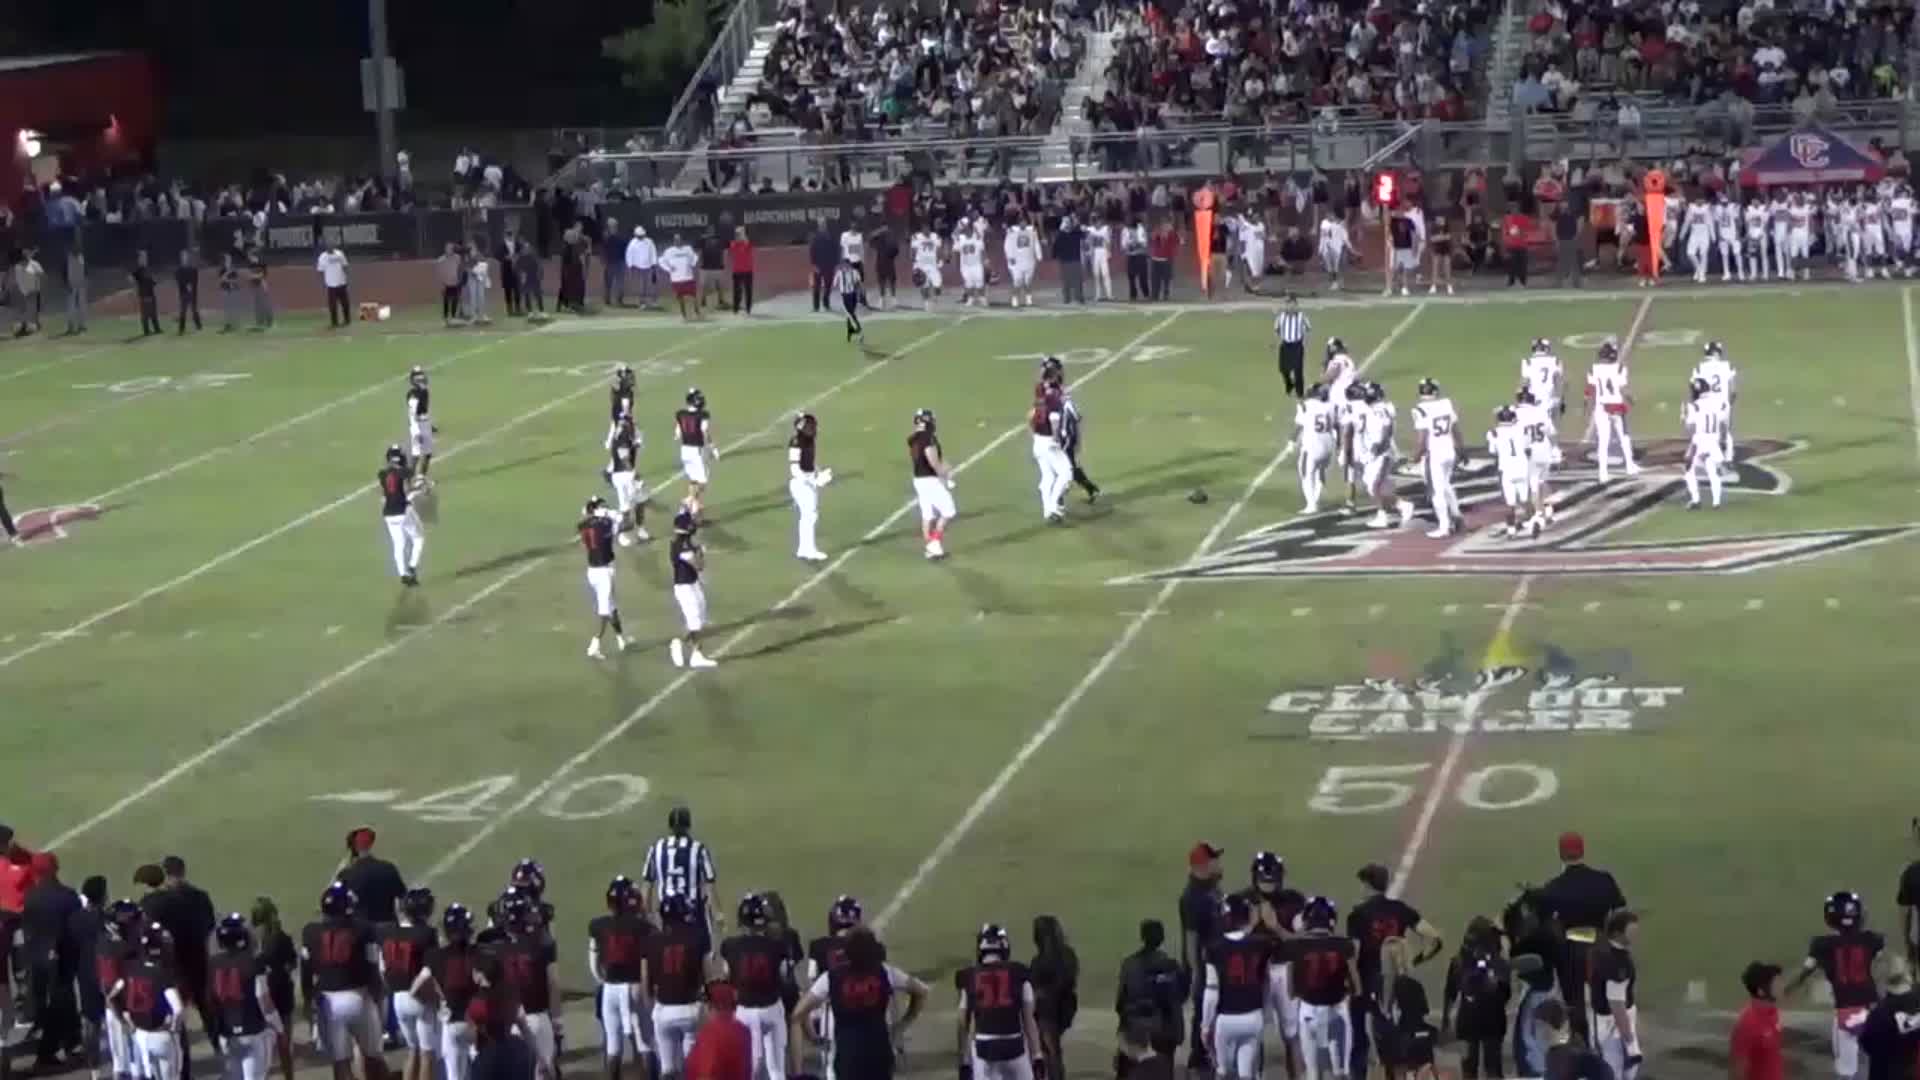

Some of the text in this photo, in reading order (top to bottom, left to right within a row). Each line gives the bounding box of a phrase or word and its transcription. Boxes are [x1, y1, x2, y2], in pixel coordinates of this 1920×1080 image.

[1379, 174, 1393, 202] 2
[1597, 377, 1615, 396] 14
[1432, 414, 1450, 437] 57
[1705, 413, 1717, 434] 11
[1508, 438, 1517, 457] 1
[386, 767, 649, 821] 40
[1307, 762, 1560, 814] 50
